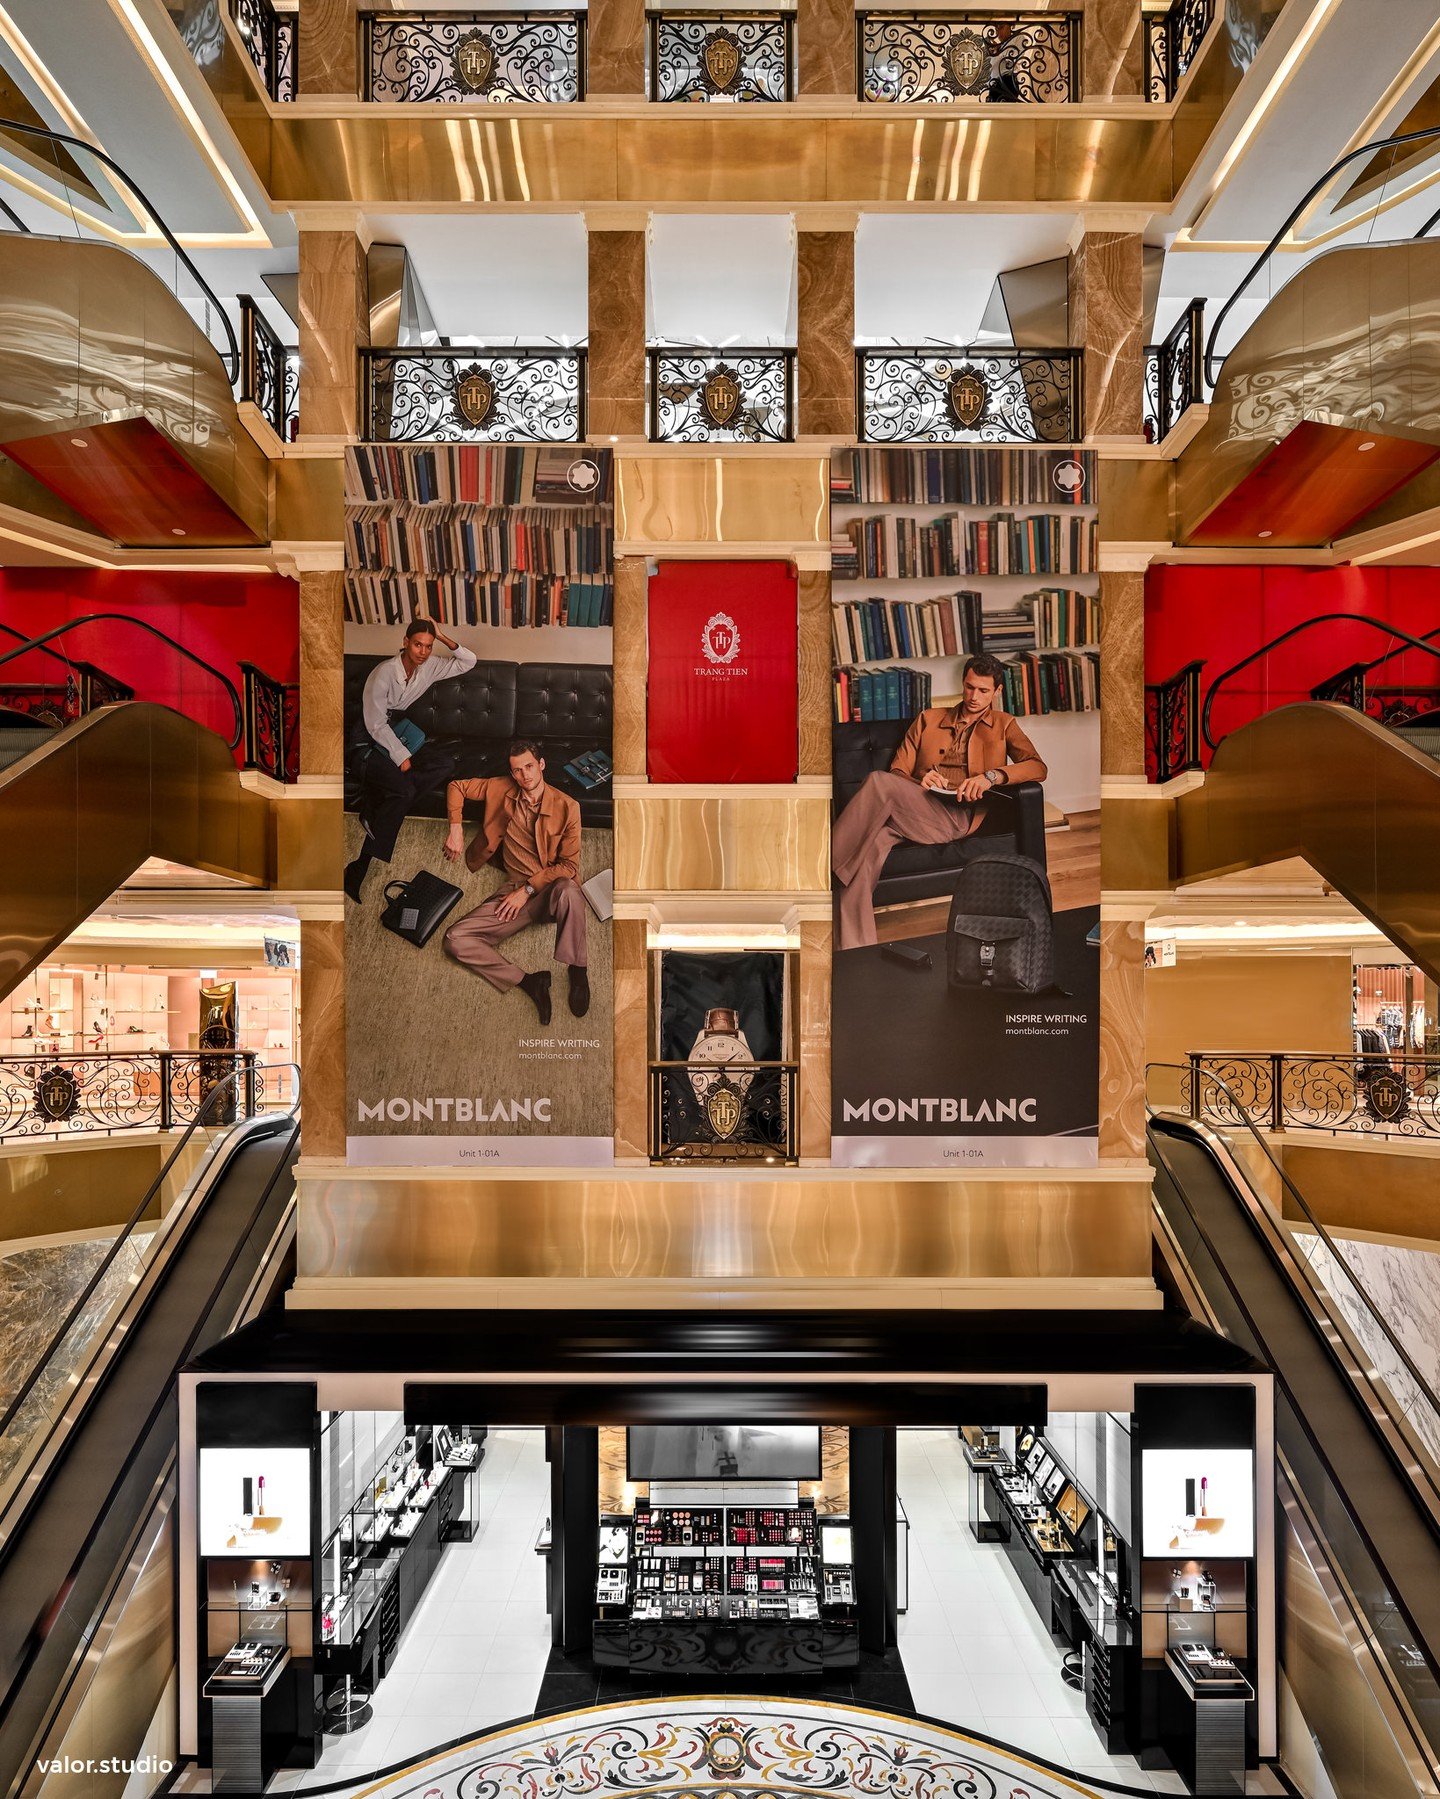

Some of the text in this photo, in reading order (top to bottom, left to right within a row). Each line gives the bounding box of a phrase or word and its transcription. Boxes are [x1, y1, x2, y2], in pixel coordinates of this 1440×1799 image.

[694, 668, 748, 676] TRANG TIEN
[1005, 1014, 1087, 1024] INSPIRE WRITING
[1005, 1027, 1069, 1036] montblanc.com
[518, 1038, 600, 1048] INSPIRE WRITING
[518, 1051, 582, 1060] montblanc.com
[357, 1097, 551, 1122] MONTBLANC
[843, 1097, 1037, 1122] MONTBLANC
[459, 1150, 499, 1158] Unit 1-01A
[943, 1149, 983, 1158] Unit 1-01A
